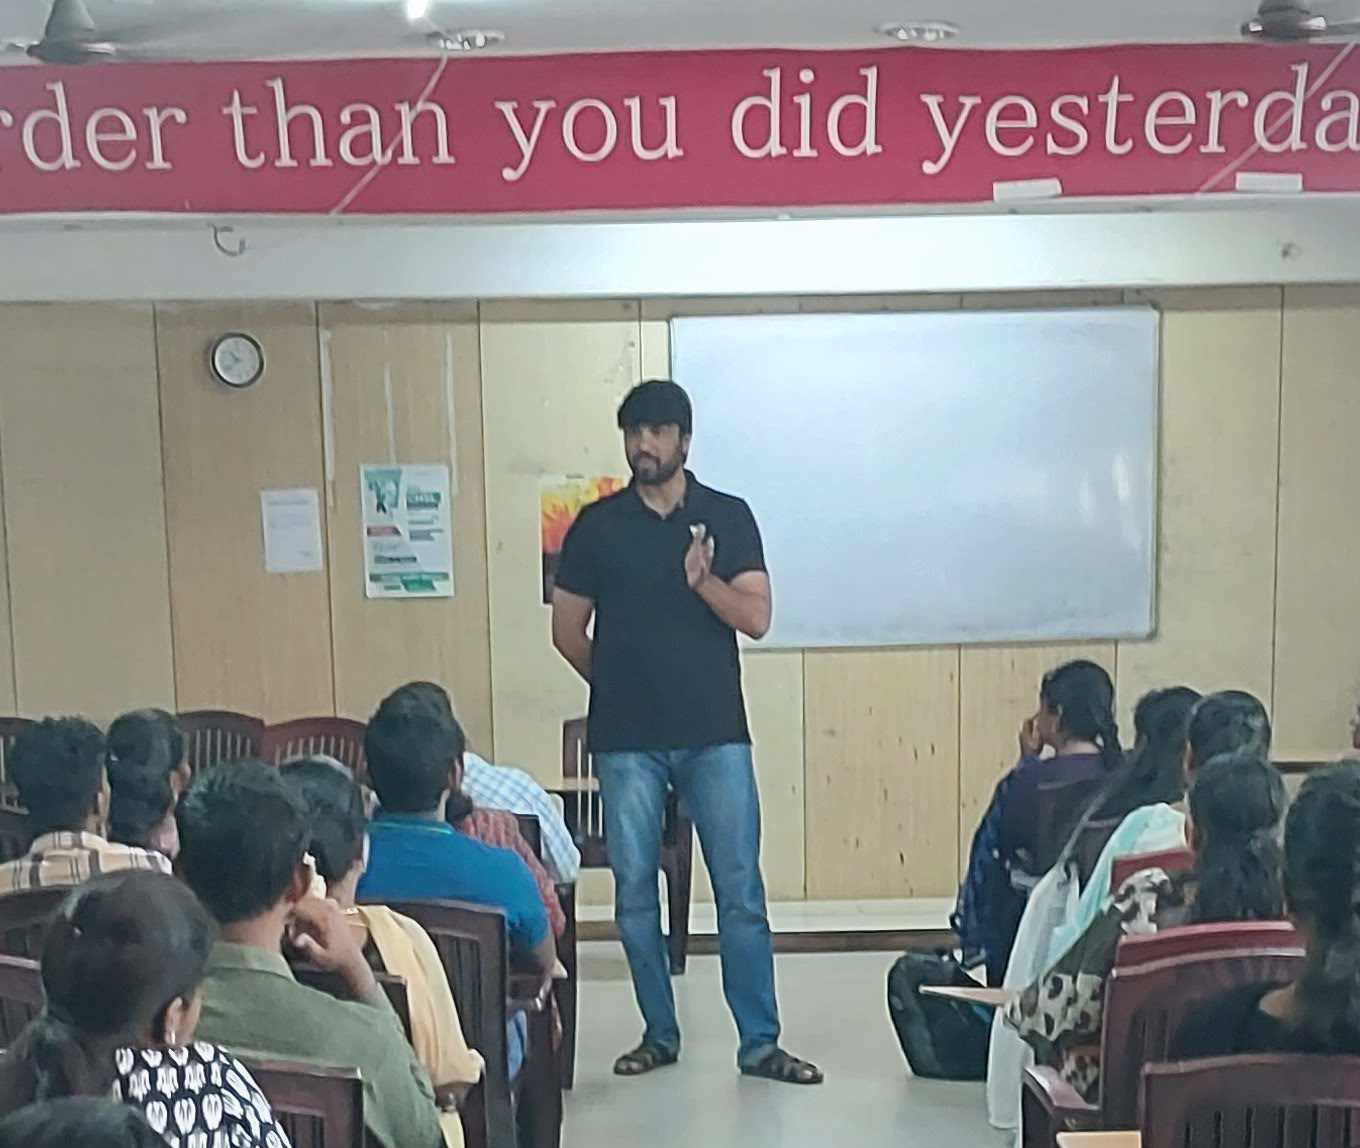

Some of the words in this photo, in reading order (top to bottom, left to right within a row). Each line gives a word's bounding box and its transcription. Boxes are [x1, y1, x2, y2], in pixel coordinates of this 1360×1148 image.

[223, 77, 456, 169] than
[494, 95, 684, 182] you
[730, 65, 883, 159] did
